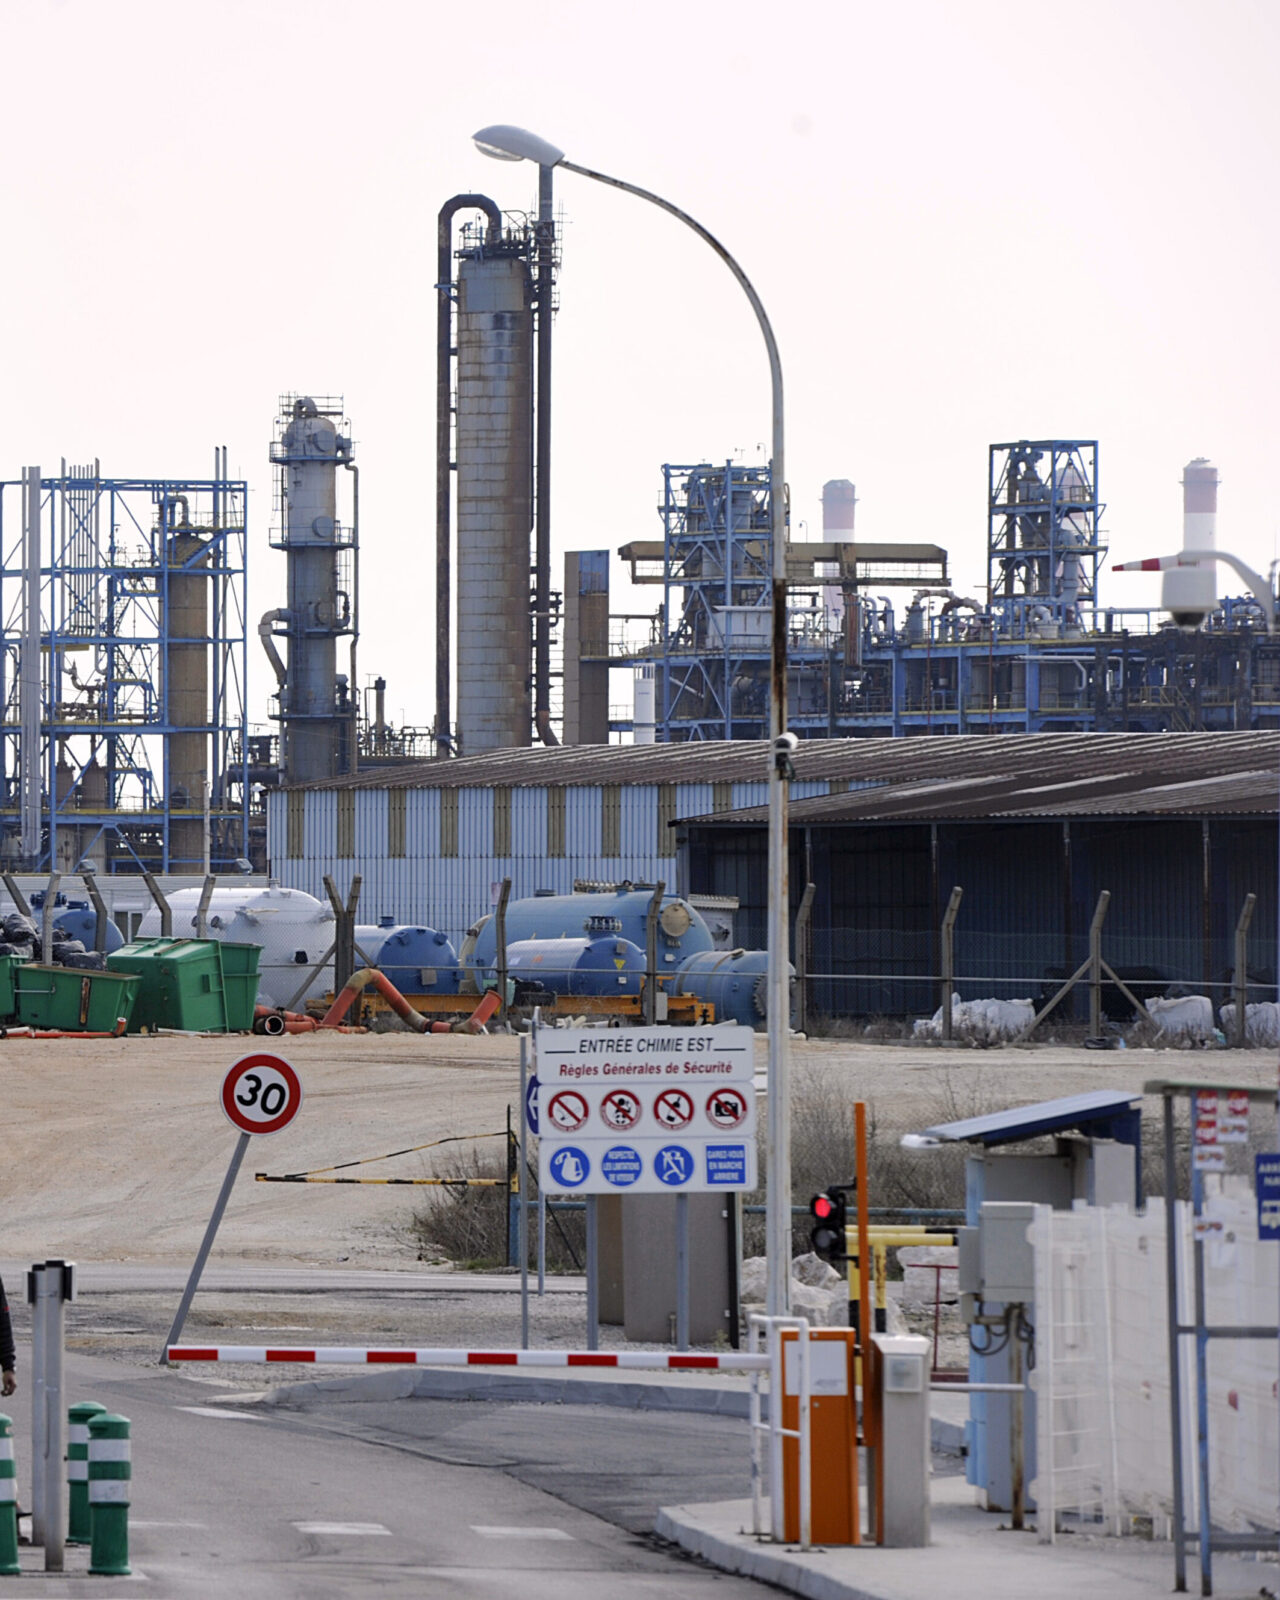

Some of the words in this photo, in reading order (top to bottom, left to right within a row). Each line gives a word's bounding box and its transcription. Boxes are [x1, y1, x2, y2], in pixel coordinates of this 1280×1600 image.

[579, 1035, 633, 1053] ENTRÉE
[636, 1037, 684, 1053] CHIMIE
[687, 1037, 714, 1052] EST
[559, 1063, 599, 1079] Règles
[602, 1062, 661, 1075] Générales
[665, 1061, 680, 1074] de
[683, 1060, 733, 1074] Sécurité
[236, 1073, 286, 1116] 30
[718, 1160, 743, 1170] MARCHE
